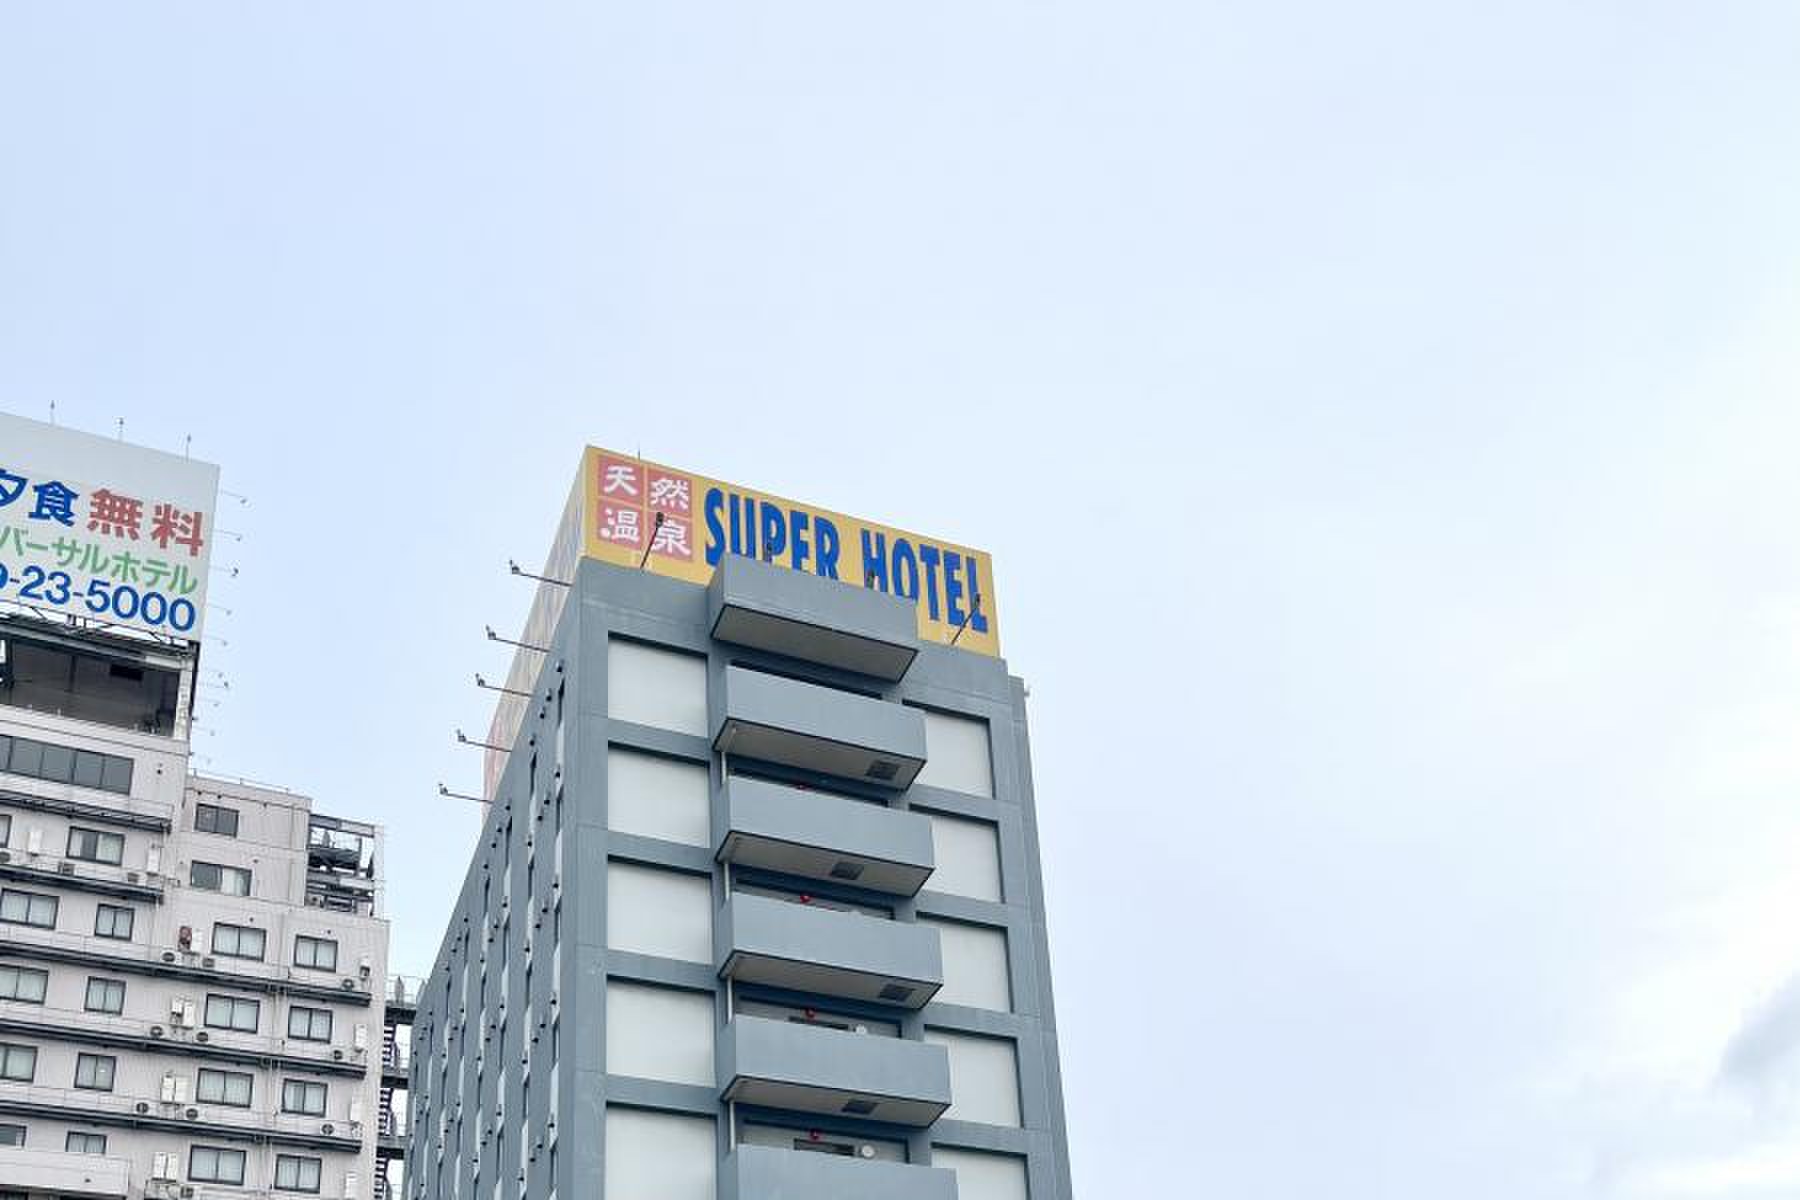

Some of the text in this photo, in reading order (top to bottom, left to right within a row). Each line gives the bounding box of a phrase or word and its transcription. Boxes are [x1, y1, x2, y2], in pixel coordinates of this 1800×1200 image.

[604, 464, 690, 511] 天然
[599, 507, 692, 558] 温泉
[704, 487, 988, 633] SUPER HOTEL
